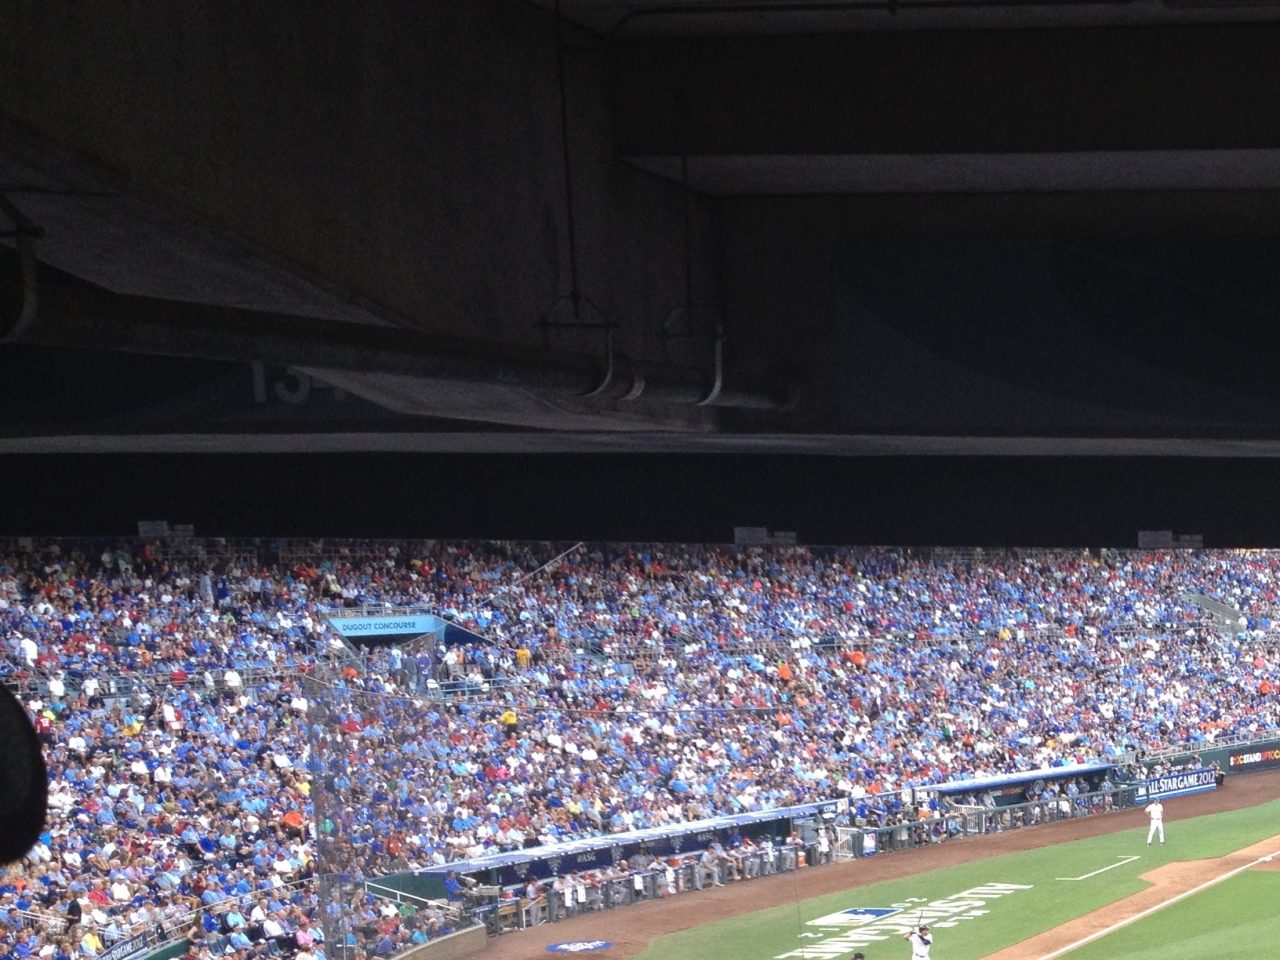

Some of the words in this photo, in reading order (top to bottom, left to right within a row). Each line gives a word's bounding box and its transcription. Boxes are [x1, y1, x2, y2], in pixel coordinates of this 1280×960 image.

[342, 623, 372, 631] DUGOUT
[373, 621, 417, 630] CONCOURSE
[1177, 774, 1199, 788] GAME
[1199, 771, 1215, 785] 2012
